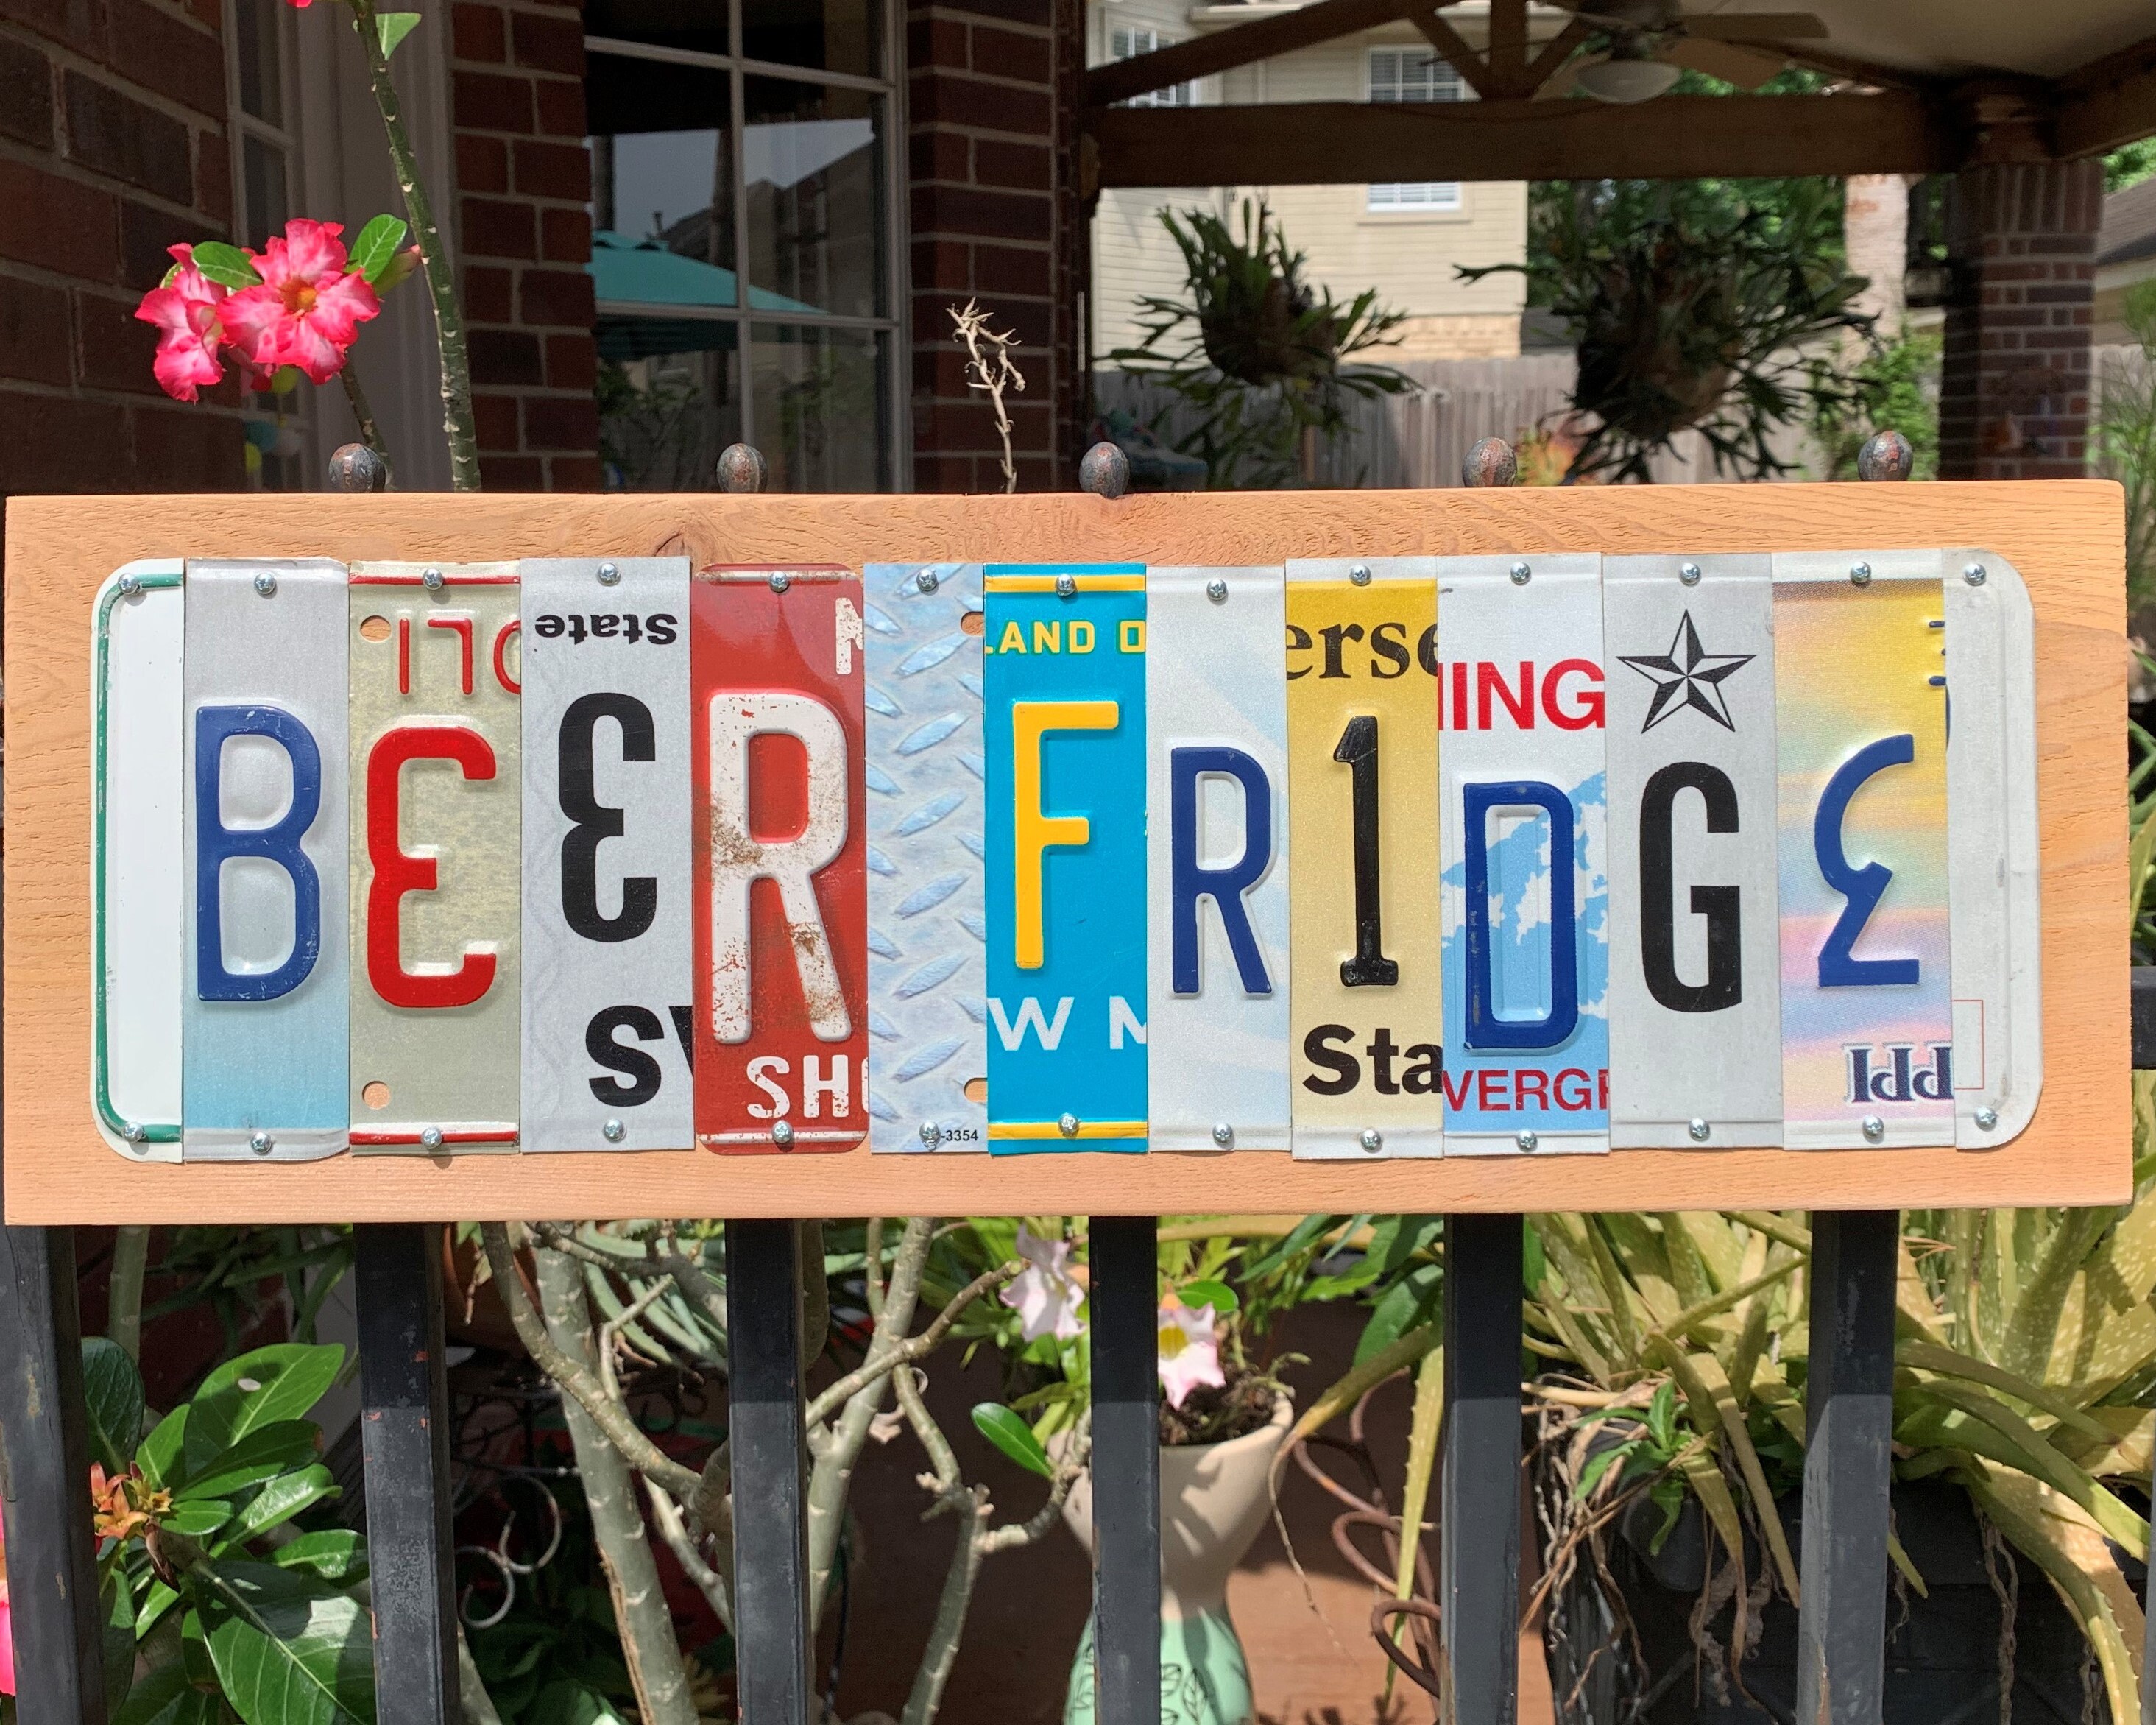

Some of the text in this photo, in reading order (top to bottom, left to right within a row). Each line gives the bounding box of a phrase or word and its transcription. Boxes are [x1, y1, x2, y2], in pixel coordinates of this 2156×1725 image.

[534, 613, 678, 645] State
[984, 620, 1095, 655] AND
[1438, 658, 1605, 731] ING
[746, 1054, 869, 1119] SH
